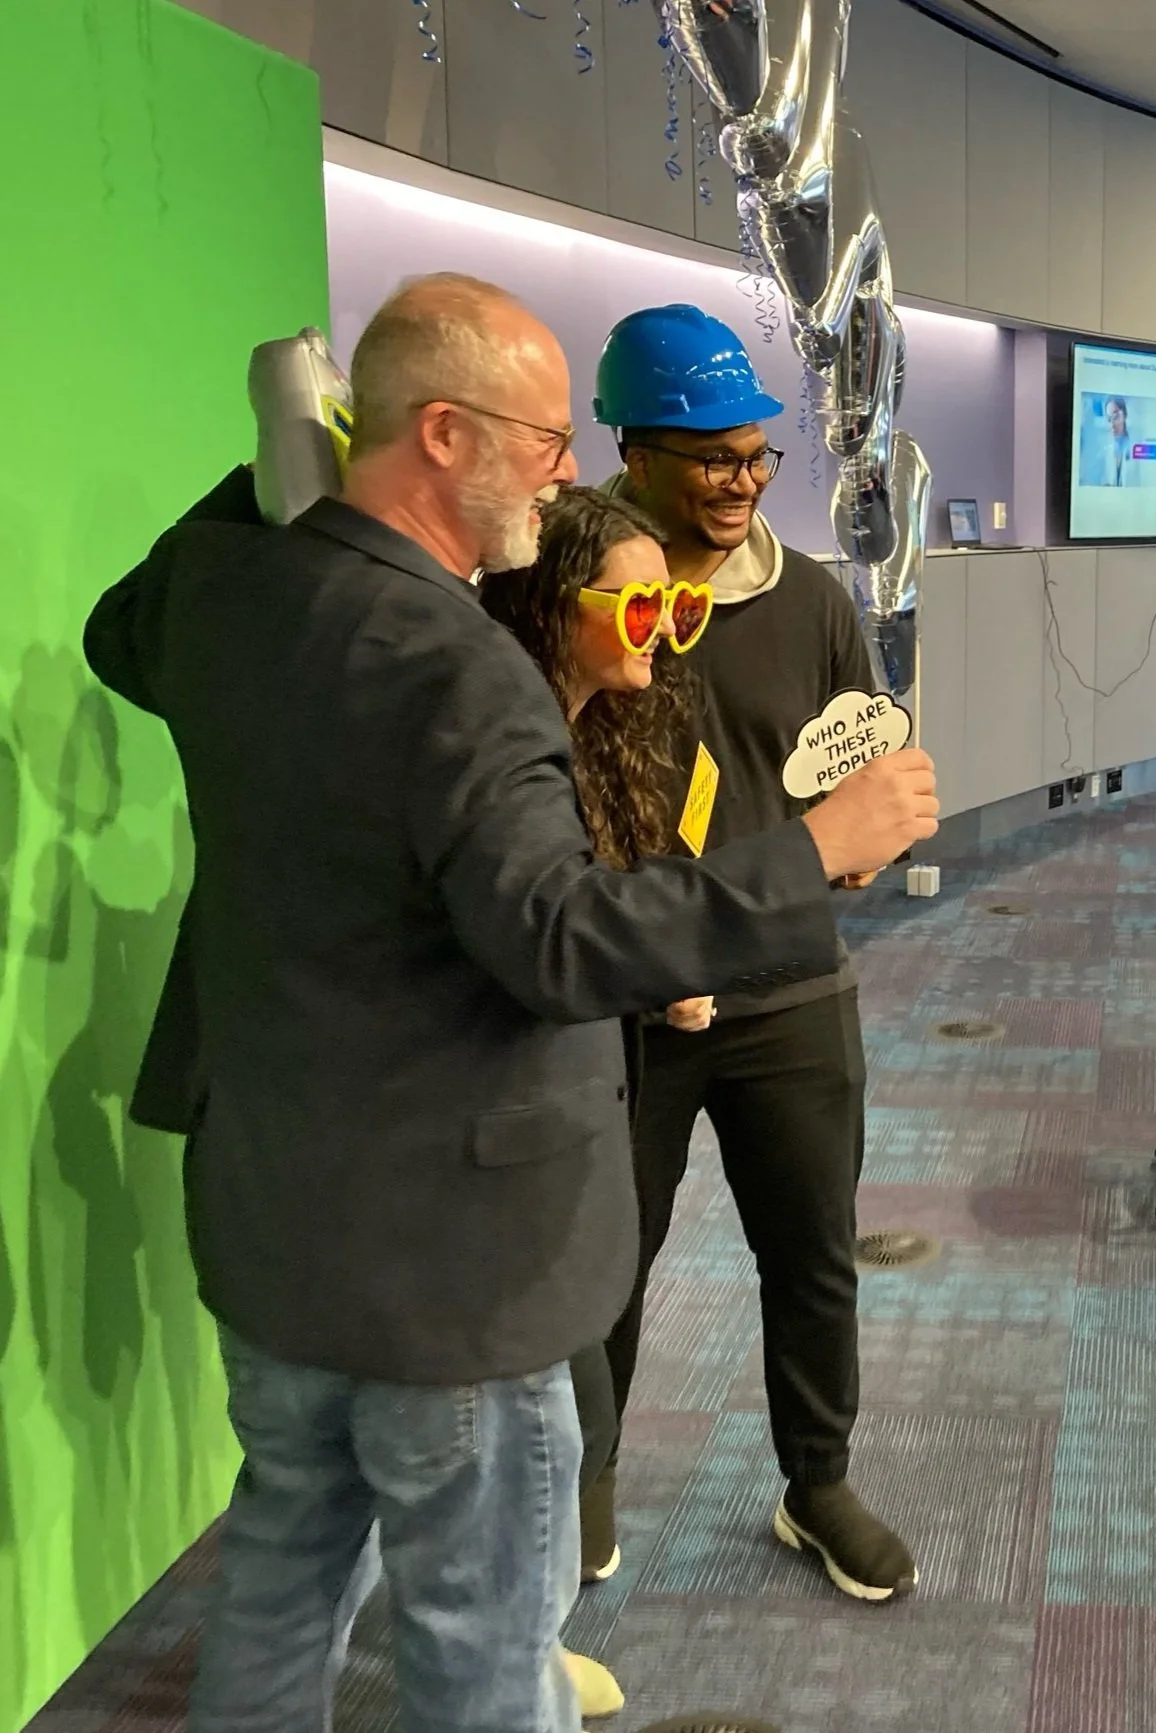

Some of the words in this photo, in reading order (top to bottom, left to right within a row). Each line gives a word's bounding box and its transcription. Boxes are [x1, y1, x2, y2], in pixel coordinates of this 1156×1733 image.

[805, 720, 847, 749] WHO
[855, 700, 887, 727] ARE
[824, 727, 877, 761] THESE
[816, 741, 889, 787] PEOPLE?
